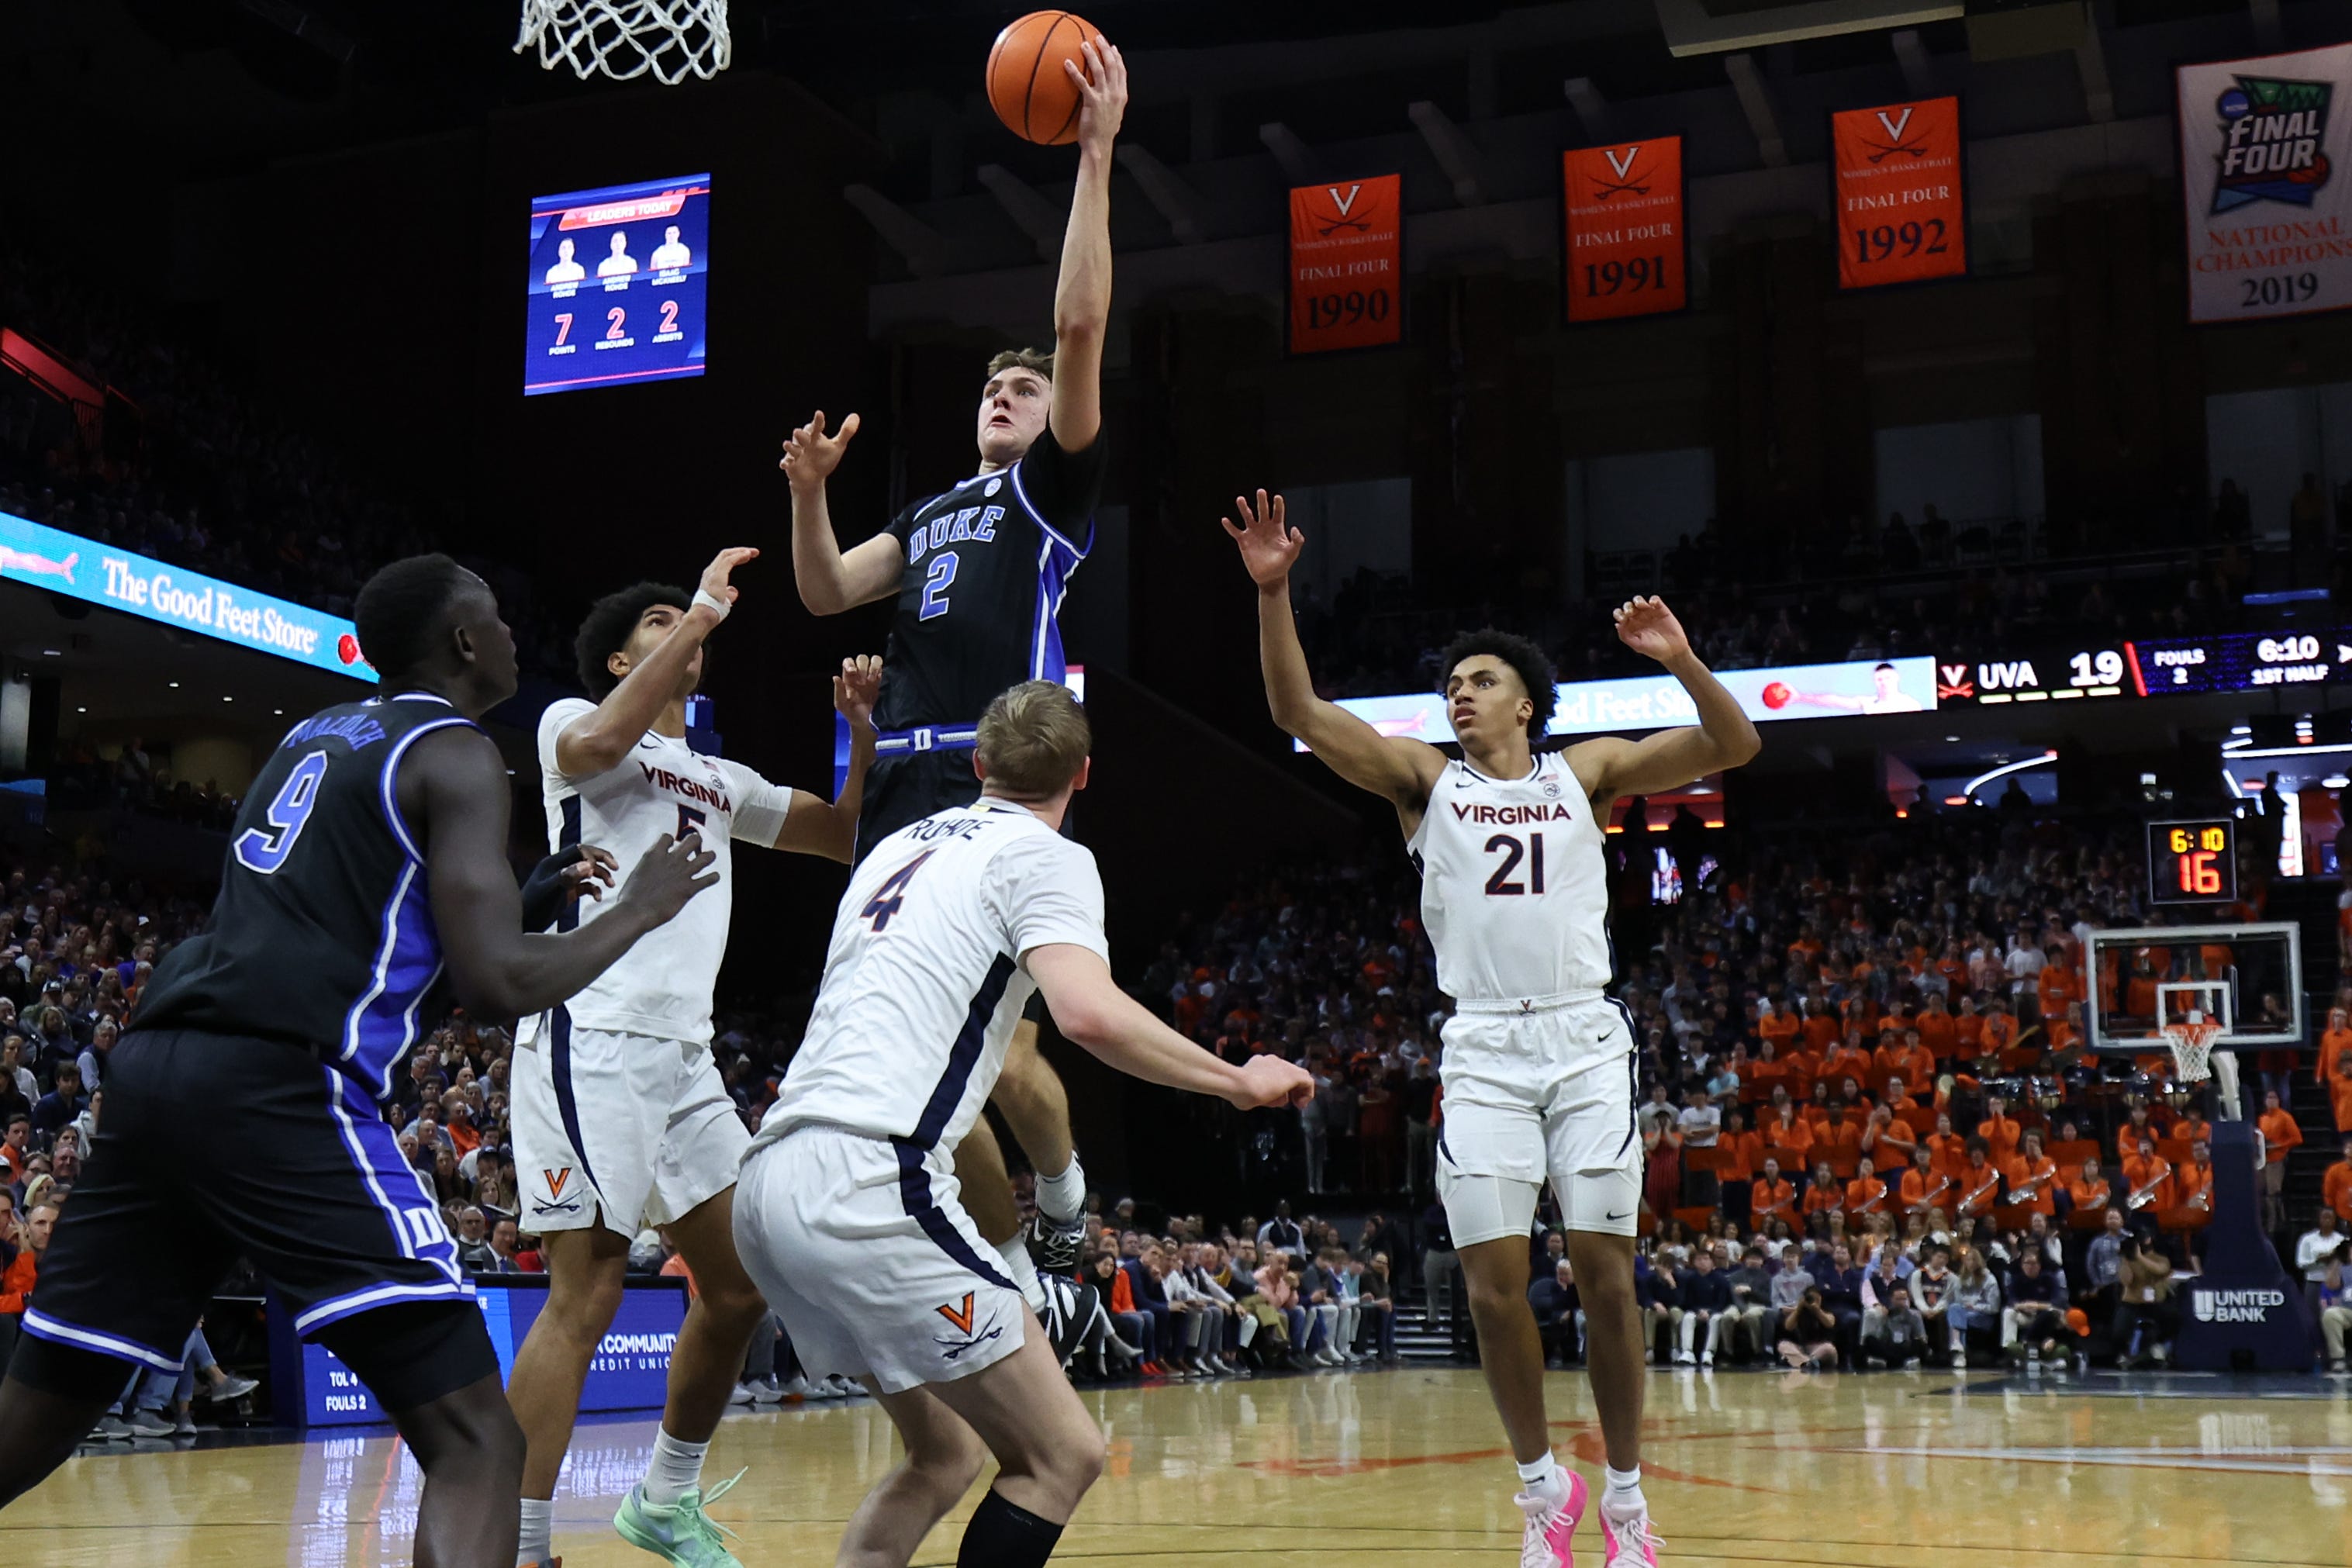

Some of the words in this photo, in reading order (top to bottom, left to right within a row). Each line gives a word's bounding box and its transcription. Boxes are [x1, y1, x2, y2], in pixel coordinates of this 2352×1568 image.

[2230, 110, 2320, 147] FINAL
[2224, 139, 2316, 177] FOUR
[587, 205, 636, 223] LEADERS
[638, 200, 673, 216] TODAY
[1848, 193, 1898, 212] FINAL
[1902, 185, 1950, 205] FOUR
[1576, 230, 1623, 247] FINAL
[1628, 223, 1673, 242] FOUR
[1856, 218, 1949, 263] 1992
[2209, 216, 2343, 248] NATIONAL
[1300, 264, 1341, 281] FINAL
[1348, 258, 1389, 276] FOUR
[1586, 255, 1666, 298] 1991
[2242, 272, 2319, 306] 2019
[606, 306, 625, 340] 2
[659, 299, 679, 333] 2
[1307, 288, 1390, 330] 1990
[554, 313, 572, 346] 7
[595, 337, 634, 351] REBOUNDS
[651, 331, 683, 344] ASSISTS
[548, 344, 575, 356] POINTS
[910, 506, 1006, 565] DUKE
[919, 551, 959, 622] 2
[102, 557, 147, 606] The
[150, 574, 212, 625] Good
[216, 591, 261, 640] Feet
[262, 608, 316, 654] Store
[2154, 648, 2205, 667] FOULS
[2257, 635, 2319, 662] 6:10
[1978, 661, 2038, 689] UVA
[2070, 650, 2123, 687] 19
[2173, 667, 2188, 685] 2
[2251, 668, 2283, 686] 1ST
[2285, 665, 2329, 684] HALF
[1593, 691, 1653, 723] Feet
[638, 761, 732, 817] VIRGINIA
[233, 749, 328, 875] 9
[1450, 802, 1572, 825] VIRGINIA
[2171, 827, 2224, 853] 6:10
[1483, 833, 1545, 896] 21
[2180, 851, 2221, 894] 16
[859, 848, 938, 932] 4
[2215, 1290, 2285, 1306] UNITED
[2216, 1307, 2267, 1322] BANK
[605, 1333, 677, 1353] COMMUNIT
[330, 1371, 349, 1387] TOL
[350, 1372, 357, 1387] 4
[590, 1357, 630, 1371] REDIT
[326, 1395, 357, 1411] FOULS
[359, 1394, 366, 1410] 2
